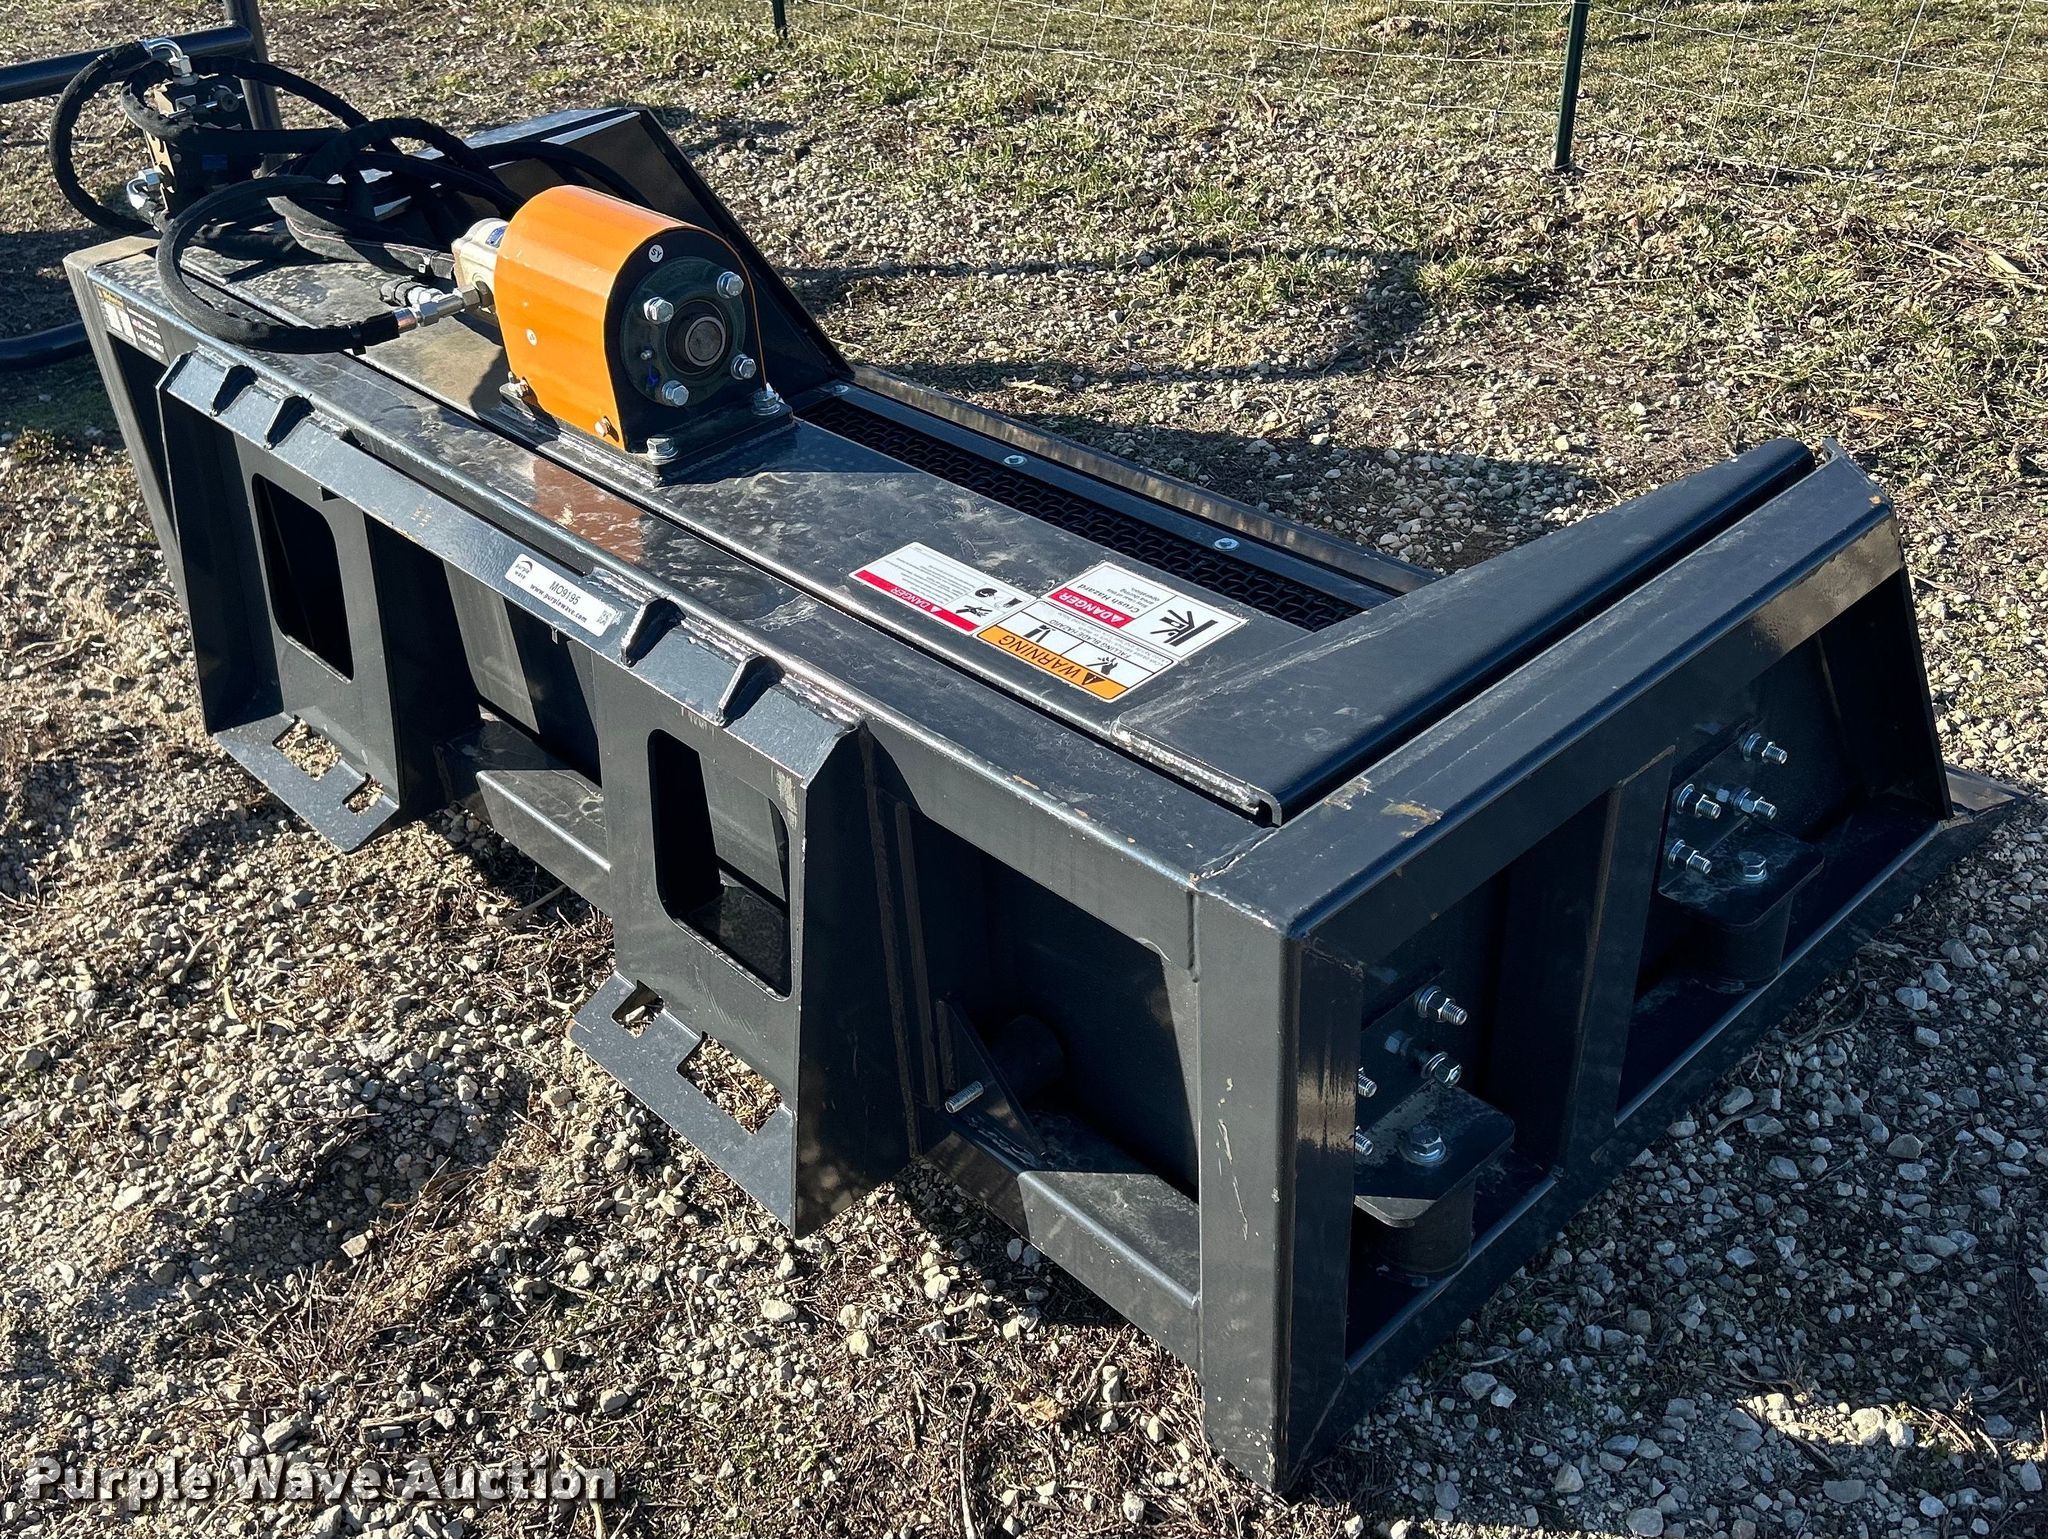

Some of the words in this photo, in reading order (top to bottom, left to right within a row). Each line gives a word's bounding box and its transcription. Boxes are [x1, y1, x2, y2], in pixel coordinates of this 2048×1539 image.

[651, 248, 662, 259] SY
[889, 587, 932, 607] DANGER
[1077, 583, 1112, 602] Hazard
[530, 584, 588, 623] www.purplewave.com
[1058, 592, 1115, 619] DANGER
[1110, 597, 1141, 613] Crush
[1049, 619, 1079, 635] HAZARD
[1075, 631, 1102, 645] BLADE
[998, 635, 1081, 678] WARNING
[1101, 642, 1131, 659] FALLING
